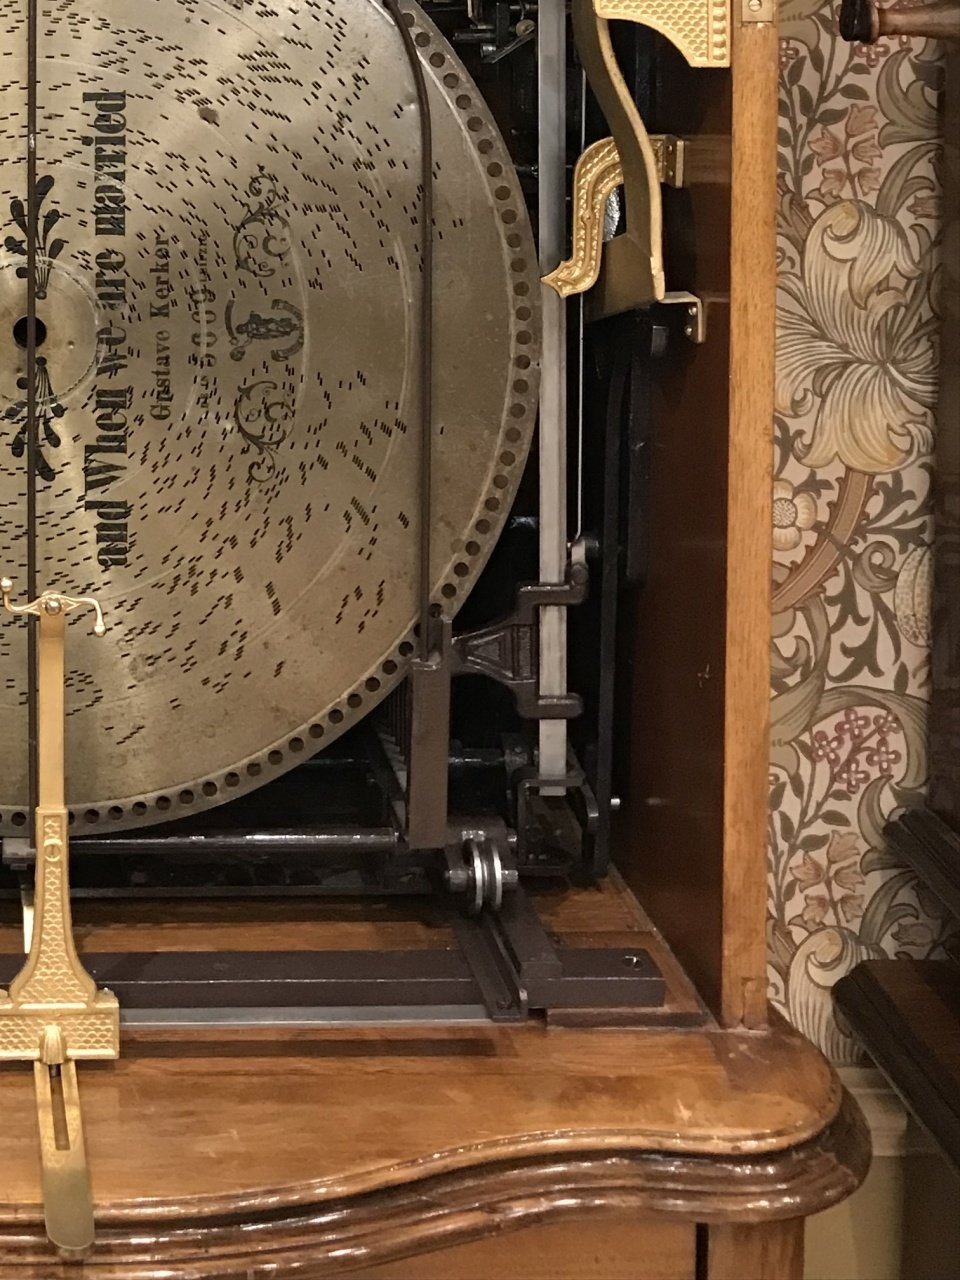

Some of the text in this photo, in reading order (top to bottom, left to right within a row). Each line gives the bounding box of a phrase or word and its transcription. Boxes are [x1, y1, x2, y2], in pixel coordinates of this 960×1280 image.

[81, 89, 128, 568] and When we are married
[148, 235, 172, 421] Gustave Kerker
